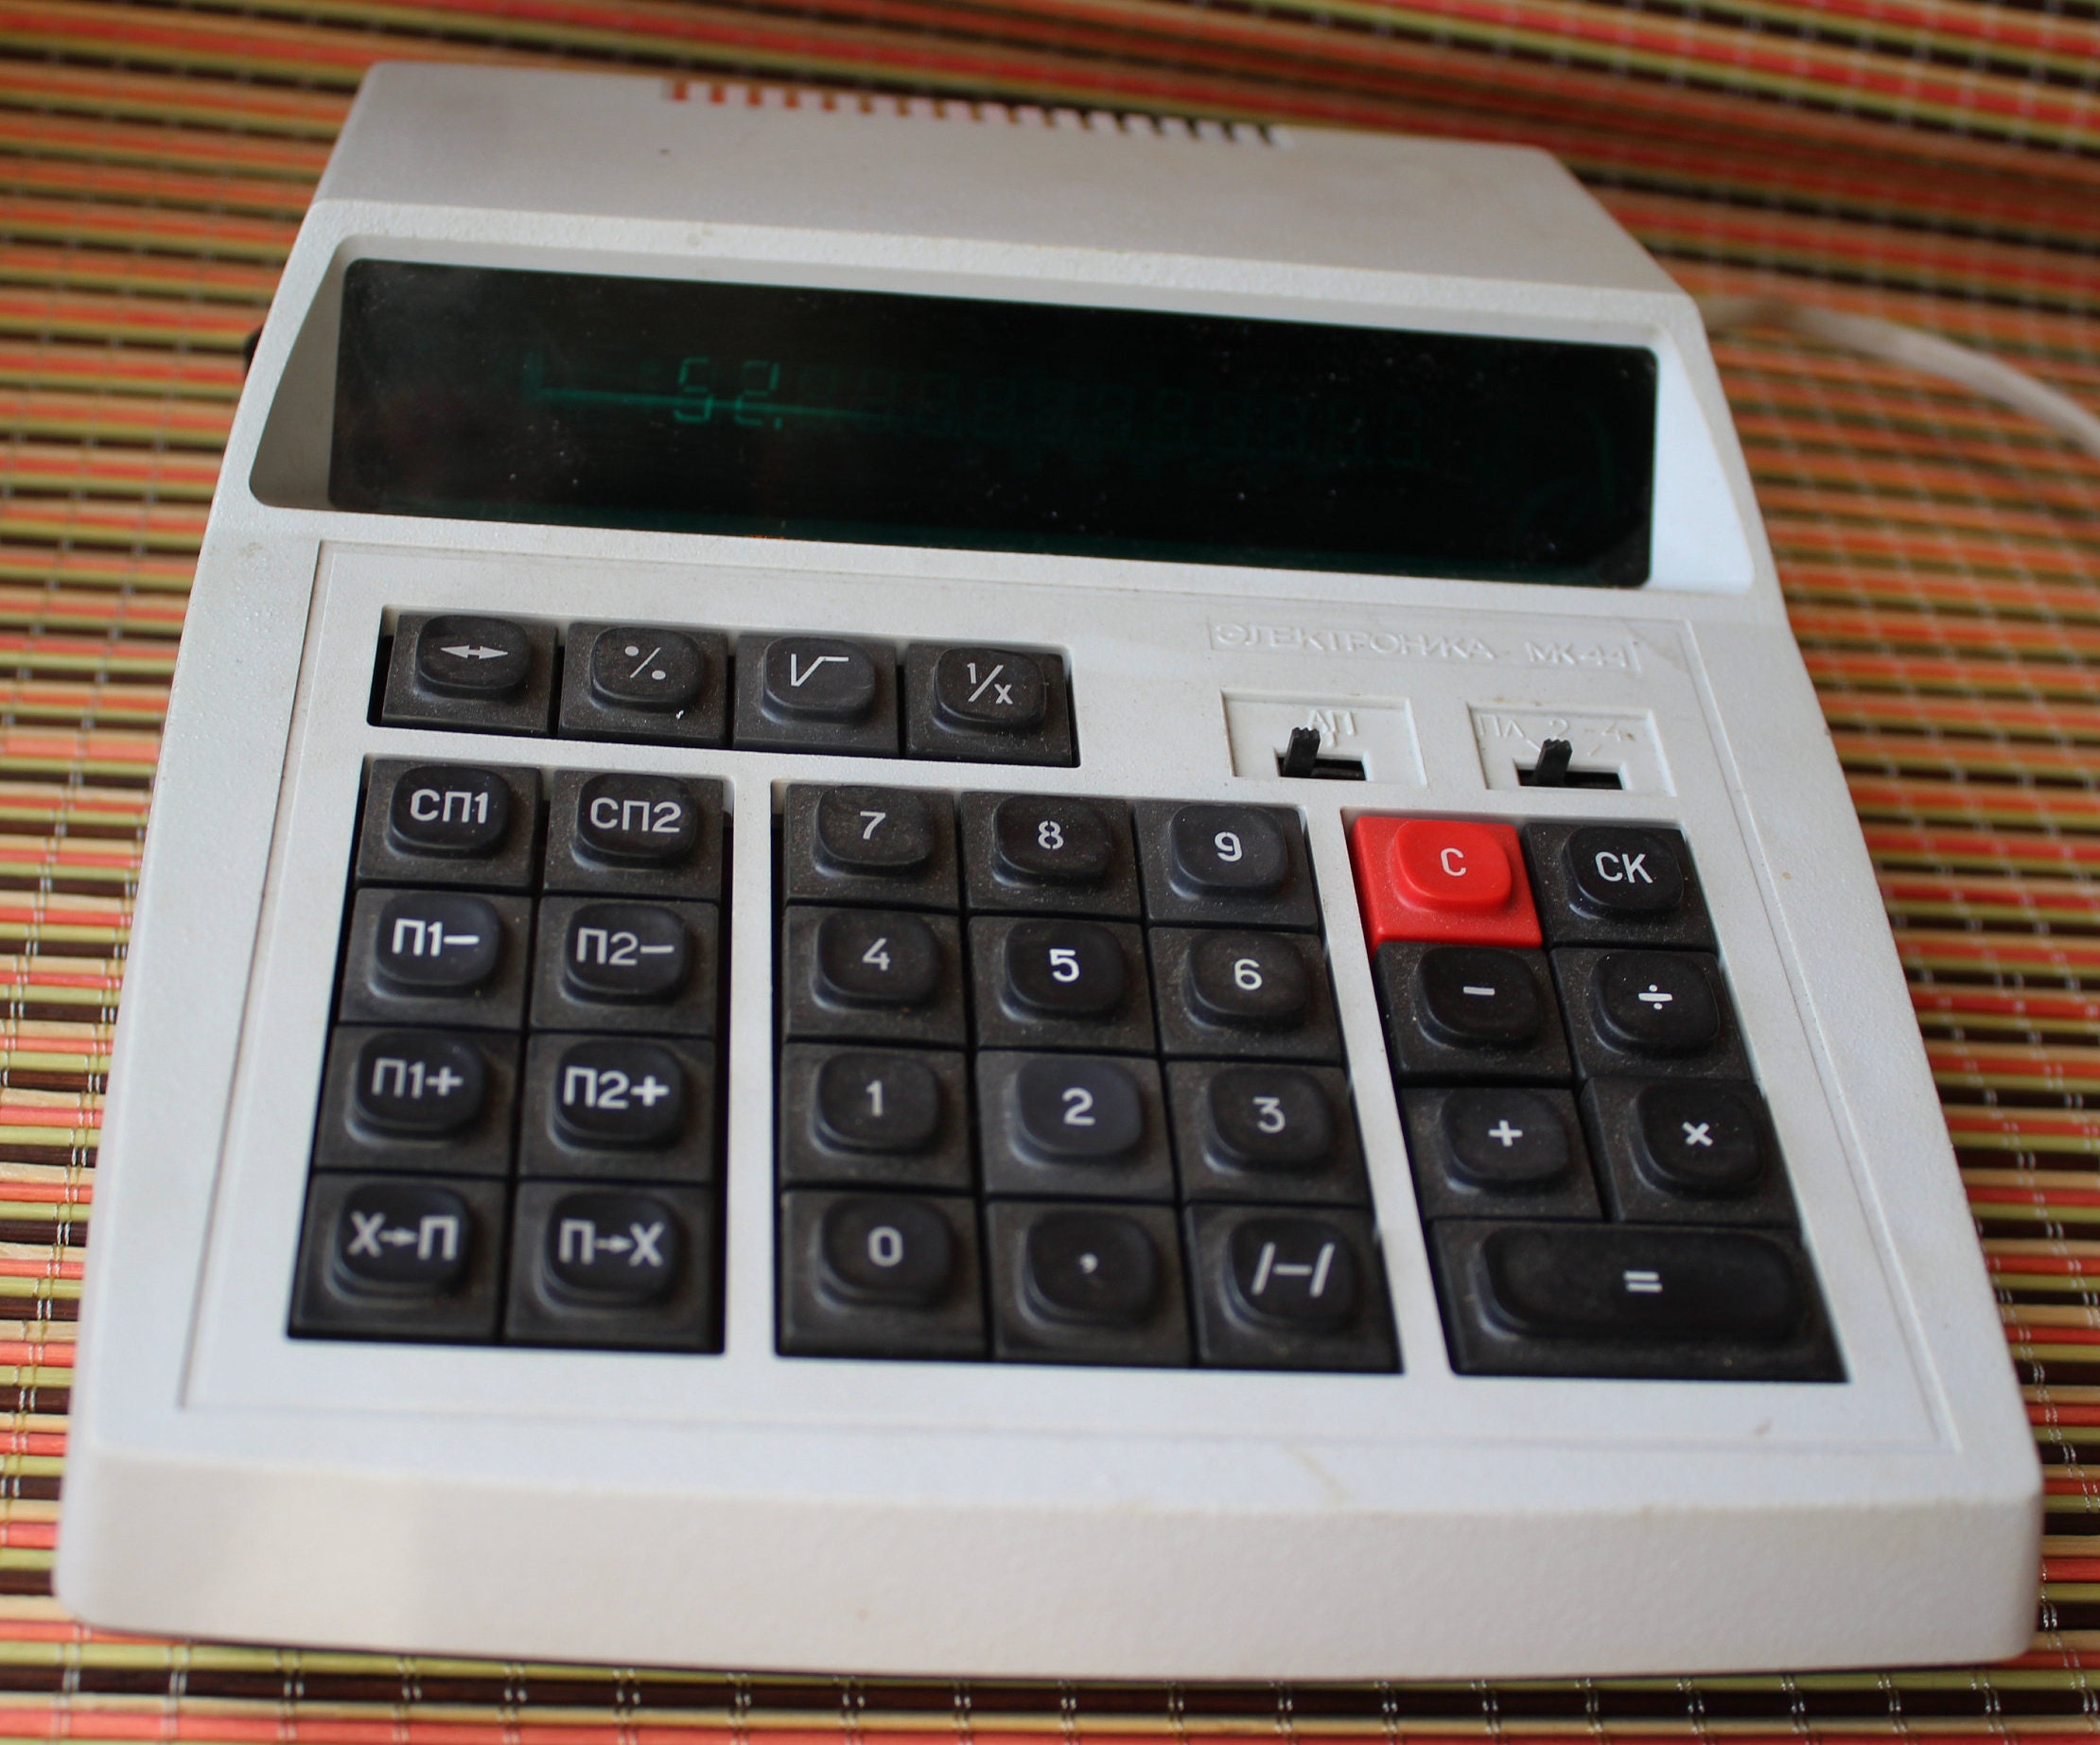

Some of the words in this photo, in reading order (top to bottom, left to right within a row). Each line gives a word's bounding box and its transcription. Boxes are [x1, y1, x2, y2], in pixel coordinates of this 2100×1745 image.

[410, 788, 489, 824] СП1
[590, 796, 682, 833] СП2
[859, 811, 886, 840] 7
[1038, 820, 1064, 850] 8
[1214, 831, 1243, 863] 9
[862, 937, 891, 971] 4
[1049, 948, 1080, 983] 5
[1234, 958, 1263, 991] 6
[866, 1080, 883, 1116] 1
[1062, 1088, 1095, 1126] 2
[1252, 1096, 1286, 1133] 3
